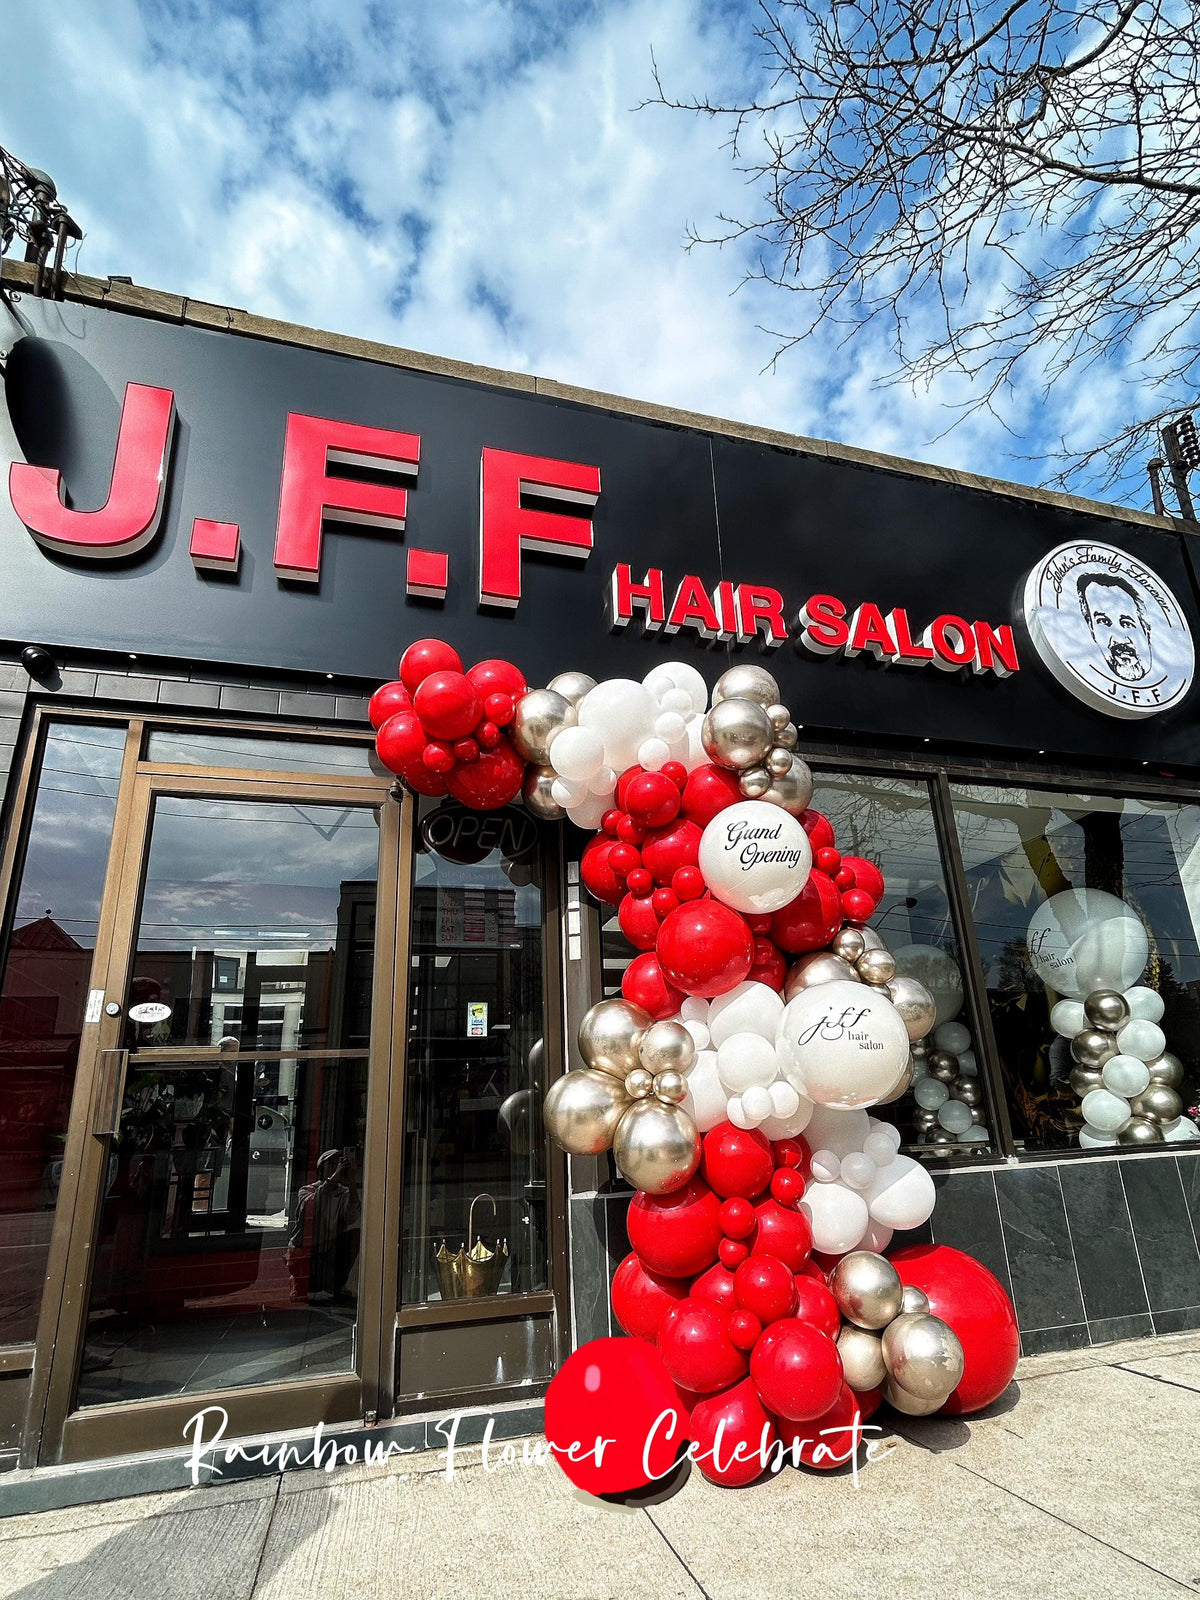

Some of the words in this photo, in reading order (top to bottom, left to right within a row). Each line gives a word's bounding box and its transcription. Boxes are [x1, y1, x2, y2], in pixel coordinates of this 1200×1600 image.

[9, 382, 602, 608] J.F.F
[1046, 556, 1077, 594] John's
[1075, 546, 1122, 574] Family
[1126, 563, 1171, 613] Forever
[611, 562, 788, 648] HAIR
[799, 594, 1020, 678] SALON
[428, 814, 528, 851] OPEN
[724, 820, 783, 851] Grand
[739, 842, 802, 872] Opening
[1038, 952, 1056, 964] hair
[1049, 957, 1075, 970] salon
[797, 1006, 872, 1046] jff
[847, 1030, 869, 1041] hair
[858, 1039, 885, 1051] salon
